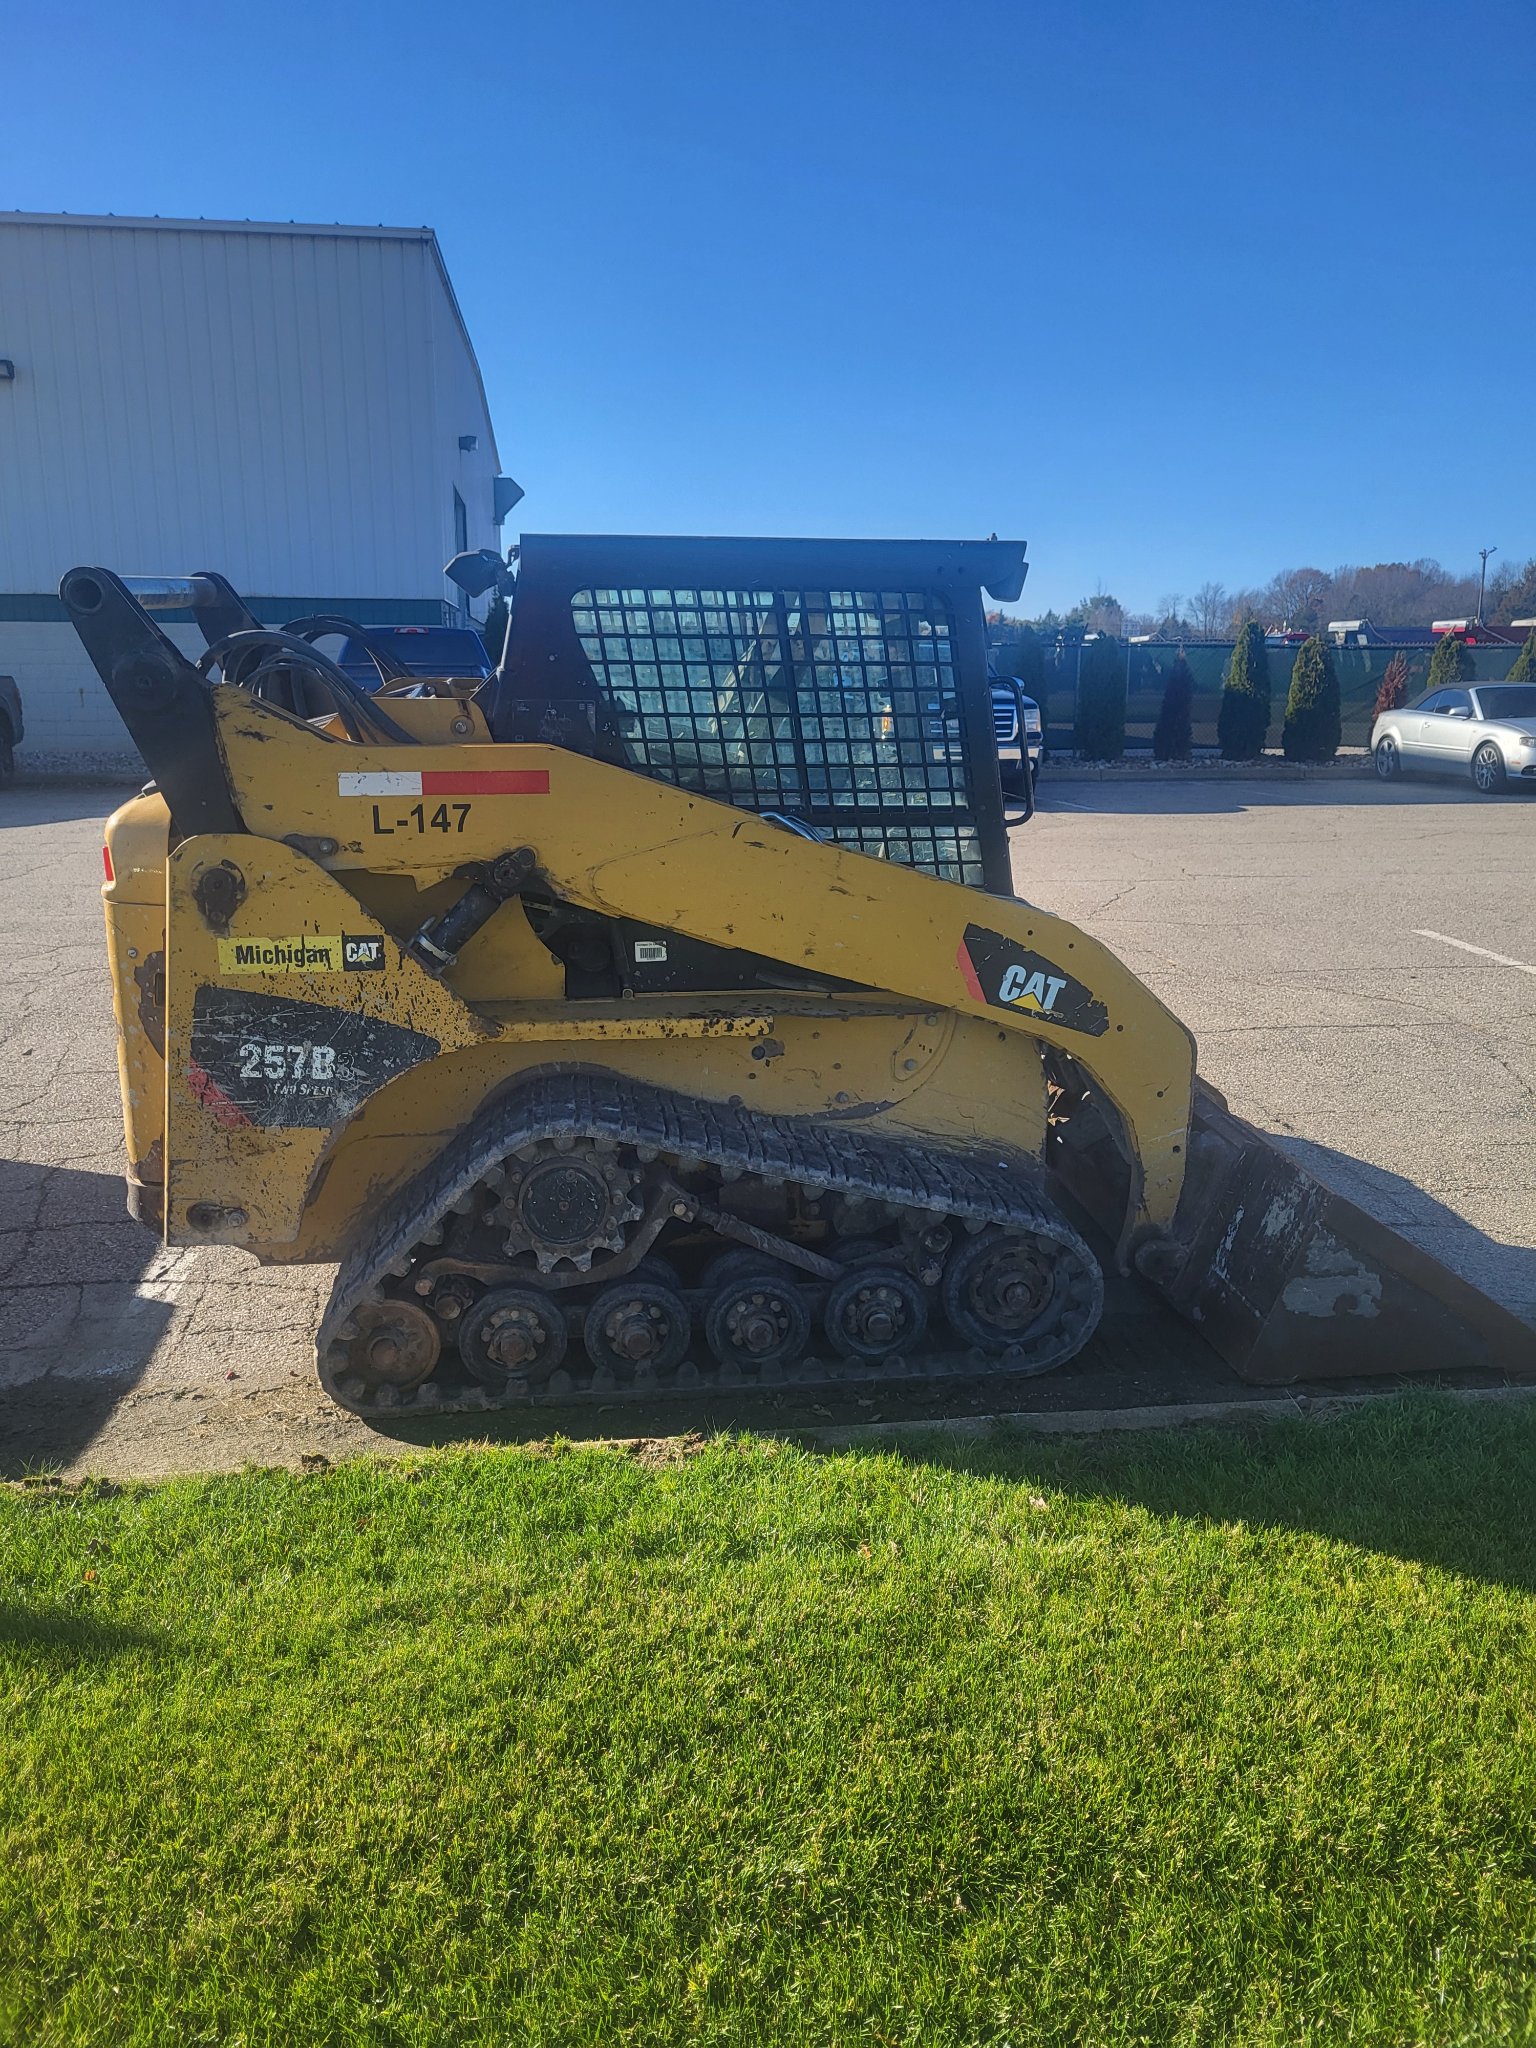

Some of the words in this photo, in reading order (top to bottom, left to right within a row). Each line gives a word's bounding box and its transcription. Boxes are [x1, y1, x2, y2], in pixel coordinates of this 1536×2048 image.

[373, 803, 471, 835] L-147
[236, 944, 331, 967] Michigan
[345, 943, 379, 963] CAT
[999, 964, 1067, 1011] CAT
